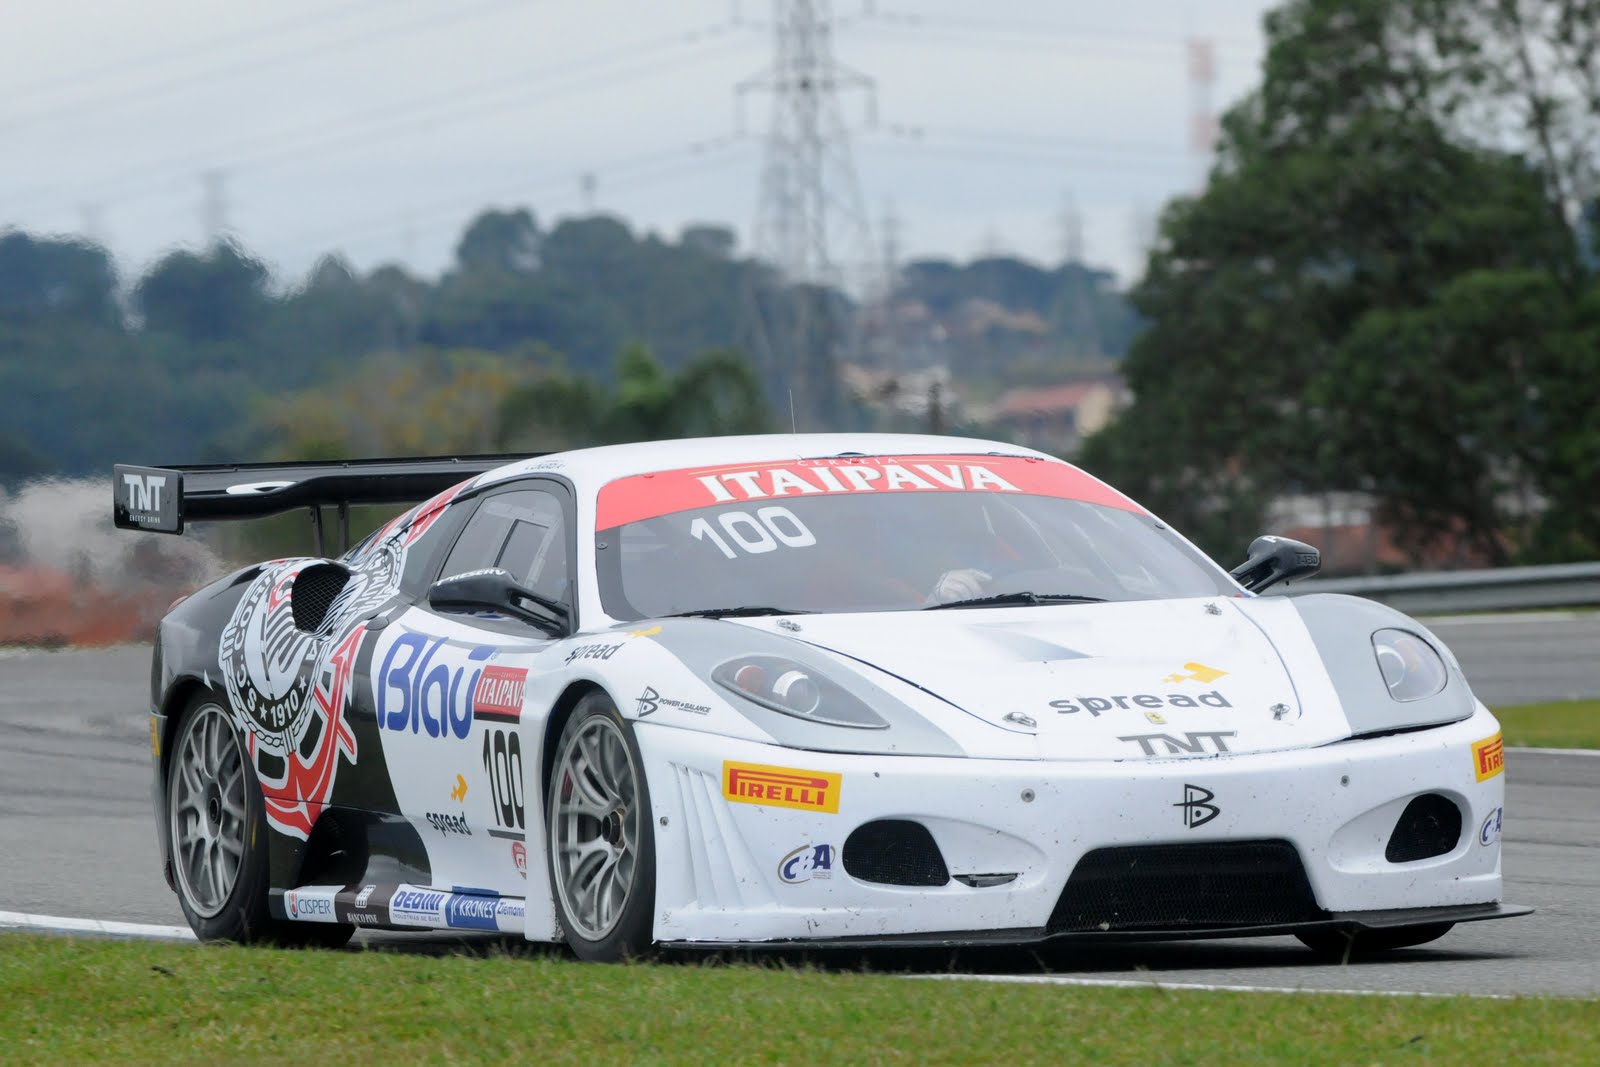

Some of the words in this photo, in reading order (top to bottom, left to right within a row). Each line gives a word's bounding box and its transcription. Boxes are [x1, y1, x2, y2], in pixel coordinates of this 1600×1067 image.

[123, 473, 167, 512] TNT
[695, 464, 1023, 502] ITAIPAVA
[690, 506, 817, 559] 100
[564, 642, 626, 666] spread
[271, 689, 299, 728] 1910
[476, 677, 528, 709] ITAIPAVA
[1048, 690, 1233, 718] spread
[1116, 730, 1238, 756] TNT
[482, 728, 525, 830] 100
[728, 767, 830, 806] PIRELLI
[425, 811, 473, 838] spread
[783, 843, 832, 880] CBA
[298, 898, 332, 916] CISPER
[393, 890, 446, 912] DEDINI
[459, 900, 496, 920] KRONES
